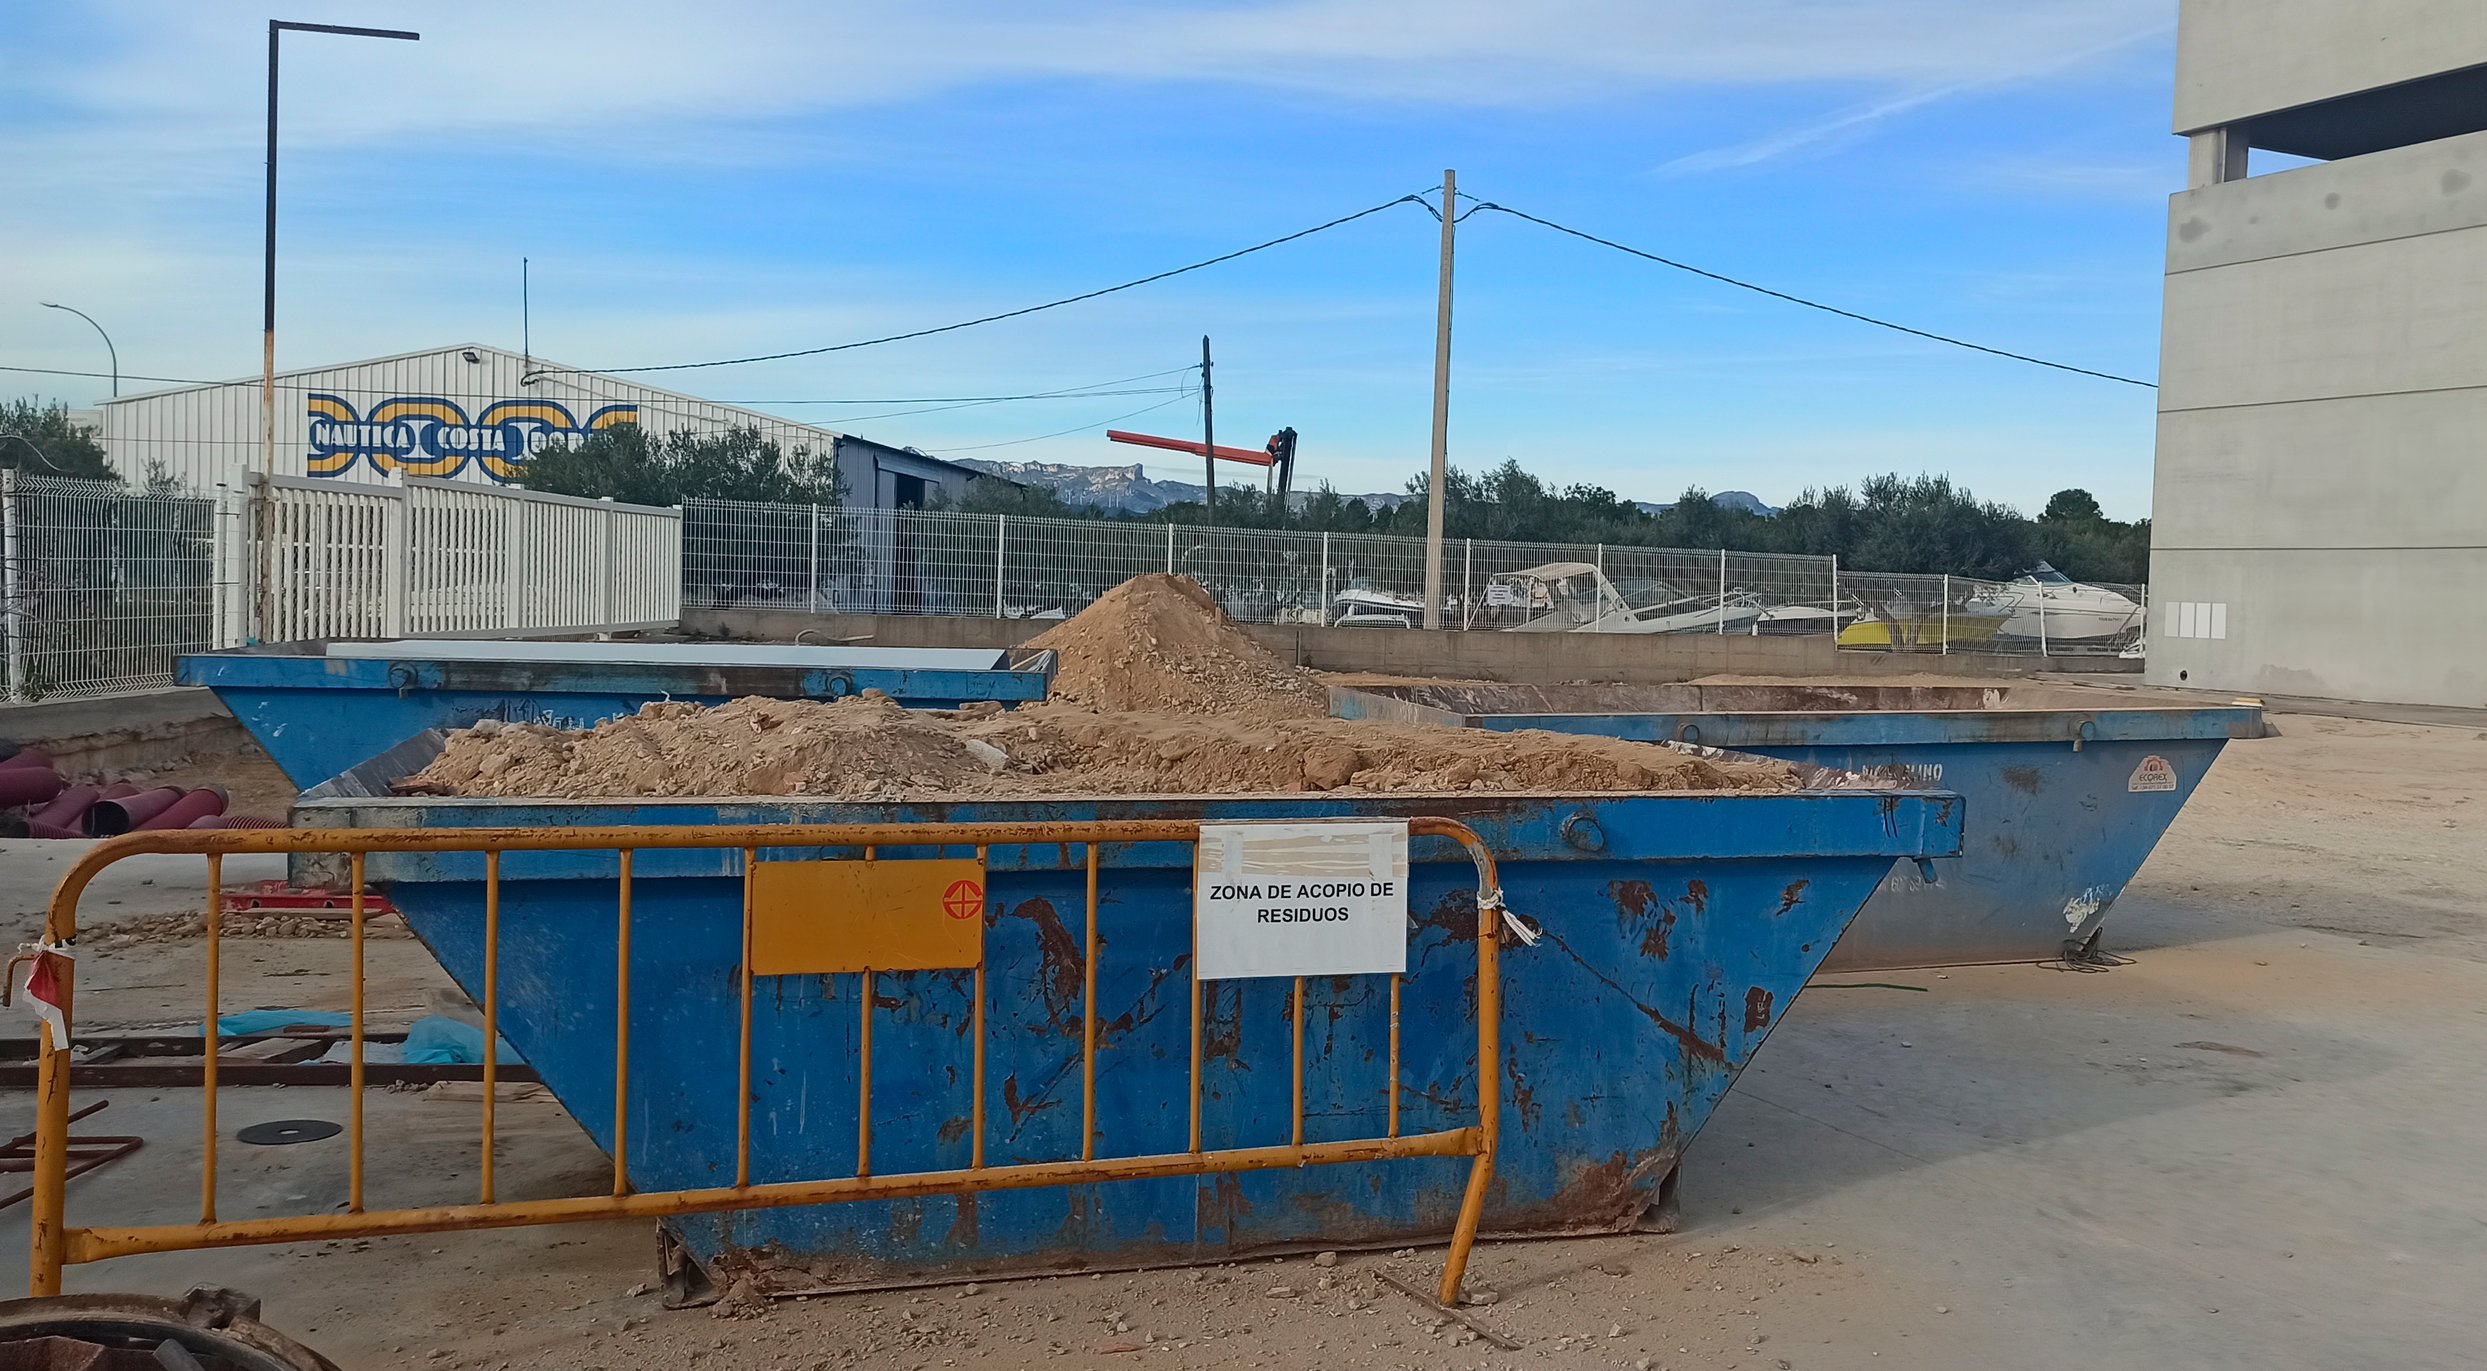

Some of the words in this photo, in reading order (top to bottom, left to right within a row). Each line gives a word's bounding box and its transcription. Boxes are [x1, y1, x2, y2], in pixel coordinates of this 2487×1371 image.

[315, 423, 411, 448] NAUTICA
[437, 426, 506, 451] COSTA
[1209, 885, 1262, 900] ZONA
[1267, 884, 1292, 899] DE
[1296, 882, 1365, 899] ACOPIO
[1370, 882, 1394, 897] DE
[1257, 907, 1349, 923] RESIDUOS
